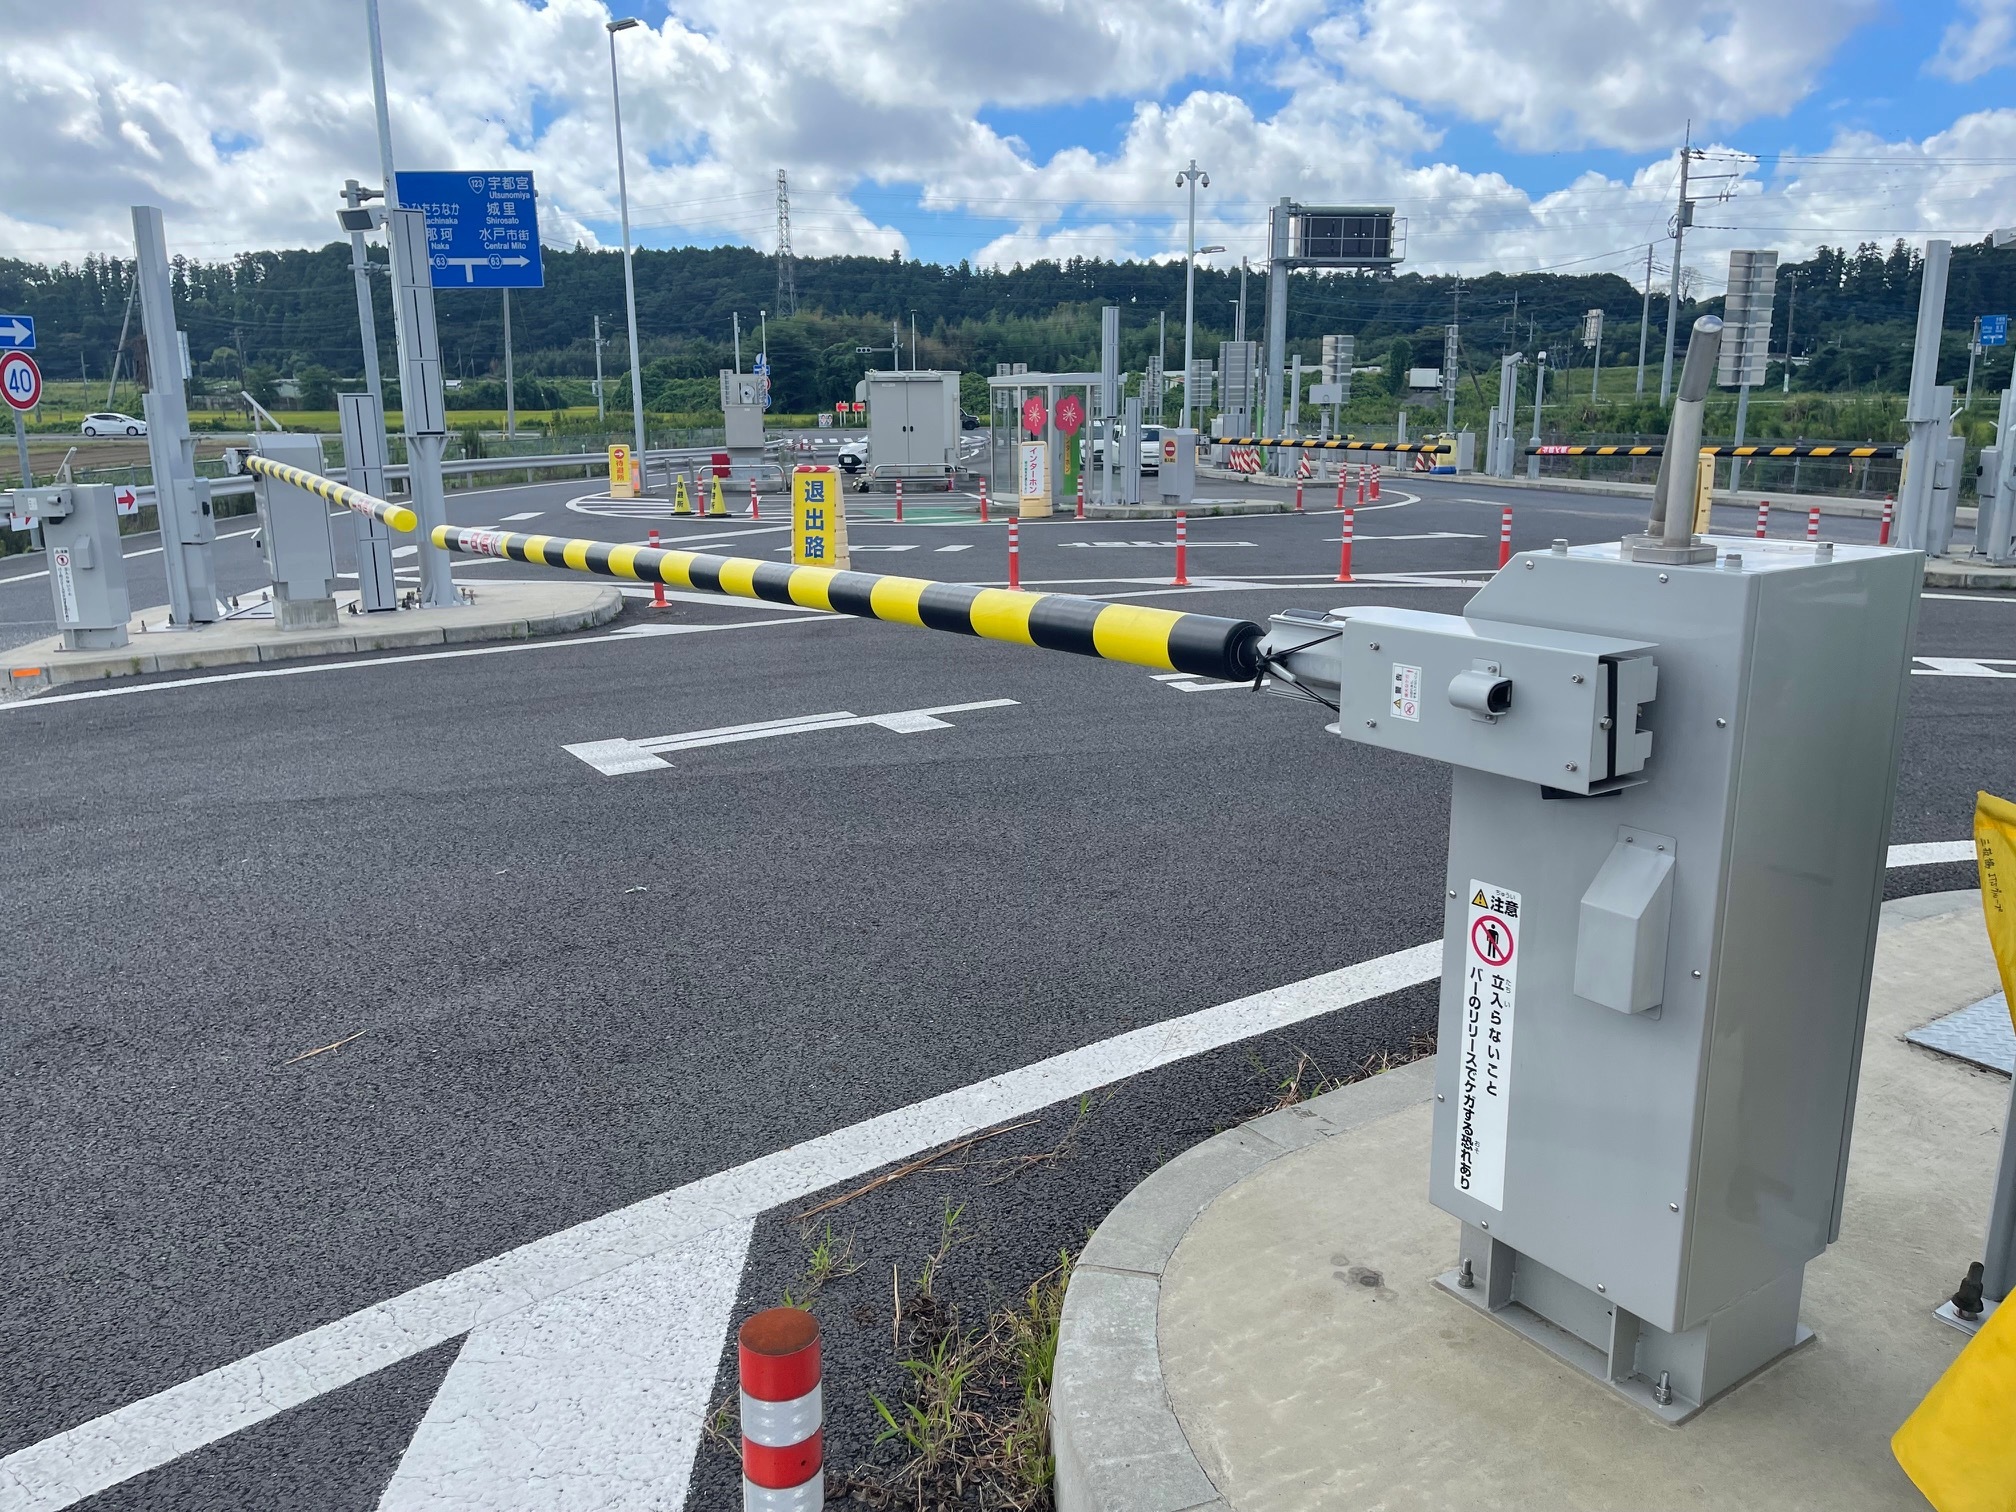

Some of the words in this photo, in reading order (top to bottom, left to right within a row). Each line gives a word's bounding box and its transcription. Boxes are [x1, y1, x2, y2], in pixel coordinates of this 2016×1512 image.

[471, 179, 483, 188] 123
[488, 176, 529, 190] 宇都宮
[489, 191, 530, 199] Utsunomiya
[487, 202, 516, 216] 城里
[486, 216, 519, 225] Shirosato
[427, 228, 453, 241] 那珂
[479, 228, 529, 241] 水戸市街
[484, 242, 510, 250] Central
[512, 242, 527, 250] Mito
[435, 257, 446, 266] 63
[490, 257, 500, 266] 63
[10, 368, 32, 393] 40
[1029, 447, 1038, 494] インターホン
[804, 480, 825, 558] 退出路
[1496, 889, 1516, 900] ちゅうい
[1490, 895, 1519, 918] 注意
[1486, 974, 1505, 1097] 立入らないこと
[1460, 966, 1483, 1190] バーのリリースでケガする恐れあり
